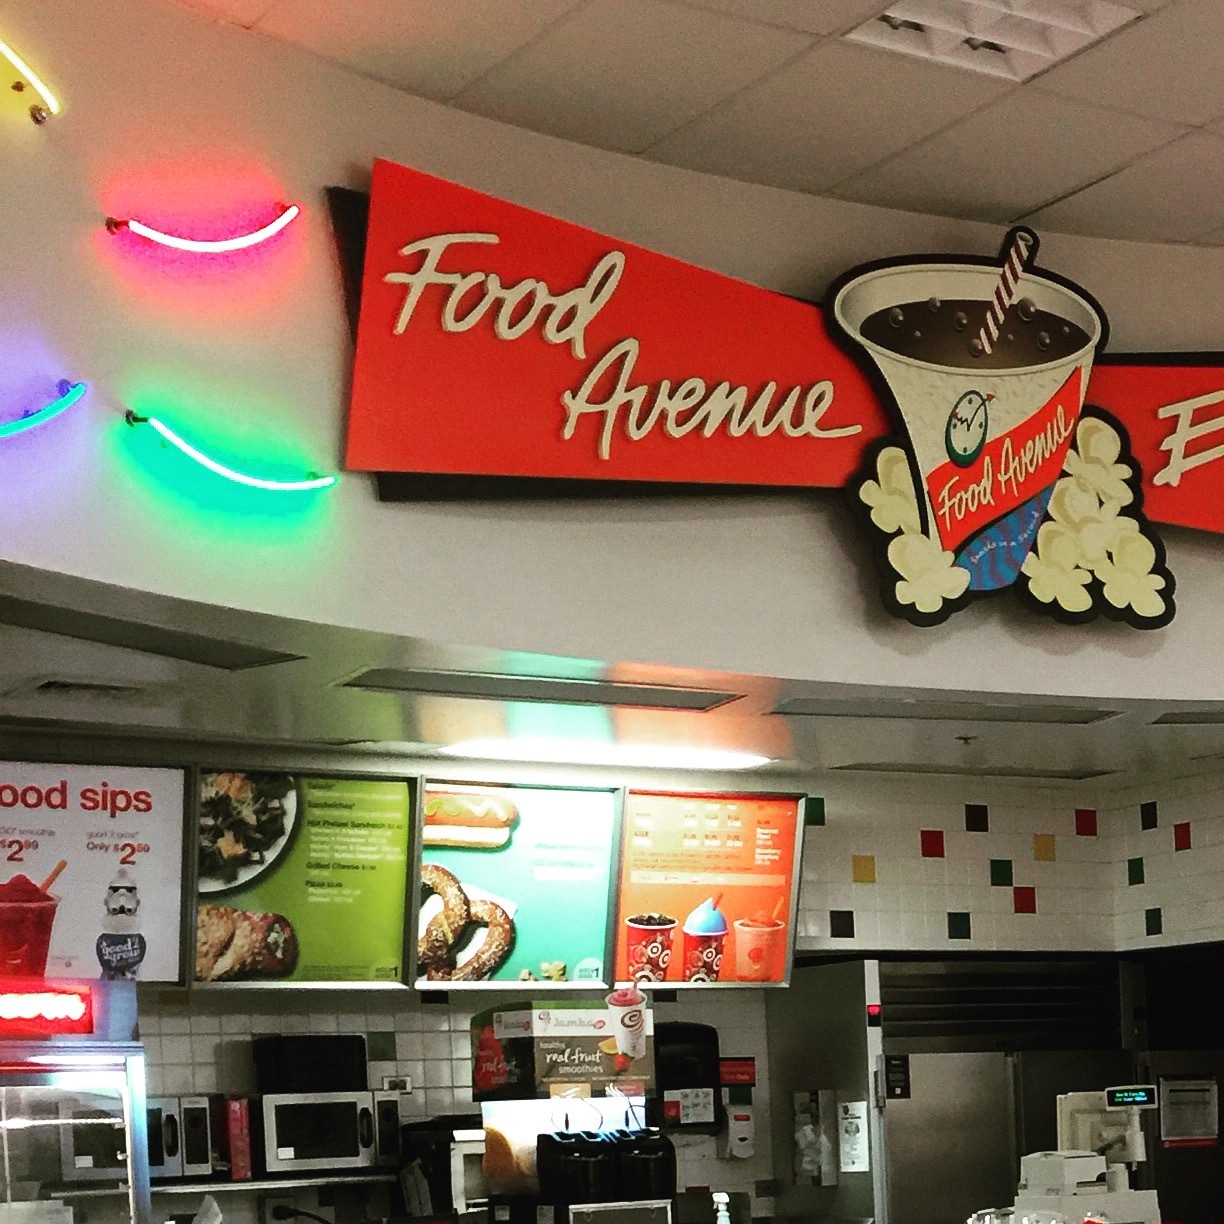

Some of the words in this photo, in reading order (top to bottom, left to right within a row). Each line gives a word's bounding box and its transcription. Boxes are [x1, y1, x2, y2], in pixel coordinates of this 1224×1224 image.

[385, 232, 626, 361] Food
[561, 337, 863, 460] Avenue
[937, 455, 996, 532] Food
[996, 404, 1076, 497] Avenue
[79, 780, 153, 818] sips
[86, 841, 110, 853] Only
[545, 1049, 570, 1064] real
[570, 1047, 603, 1064] fruit
[557, 1064, 604, 1074] smoothies
